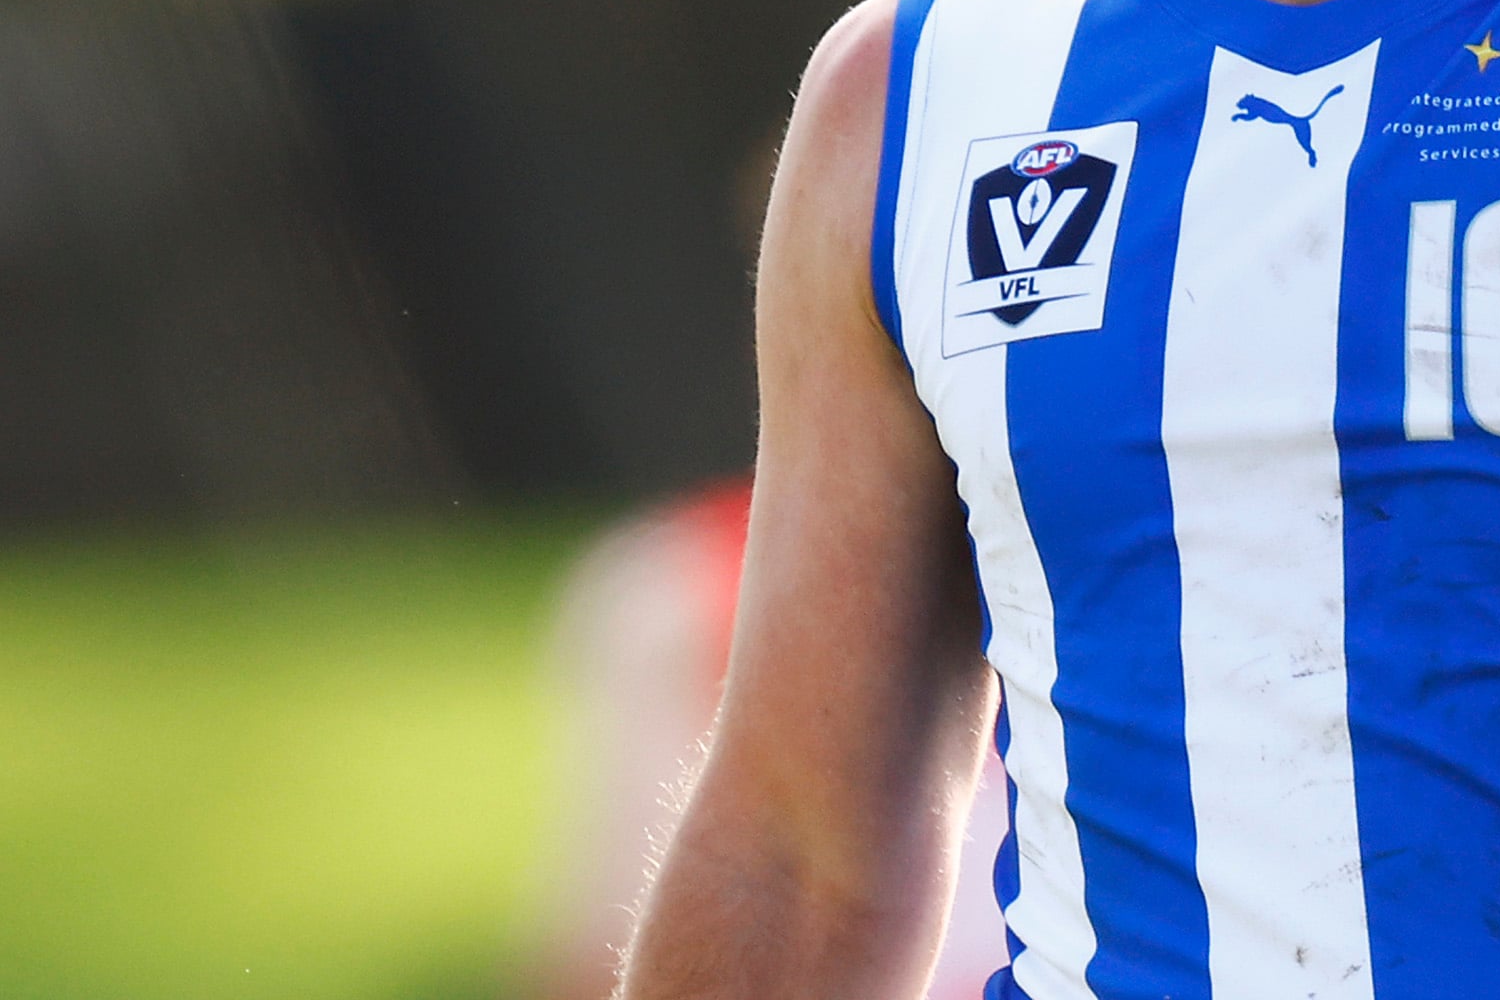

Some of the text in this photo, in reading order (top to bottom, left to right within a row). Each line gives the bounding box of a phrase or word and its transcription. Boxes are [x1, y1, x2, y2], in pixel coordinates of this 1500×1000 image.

[1016, 147, 1073, 171] AFL
[1419, 146, 1500, 162] Services
[1000, 276, 1041, 301] VFL
